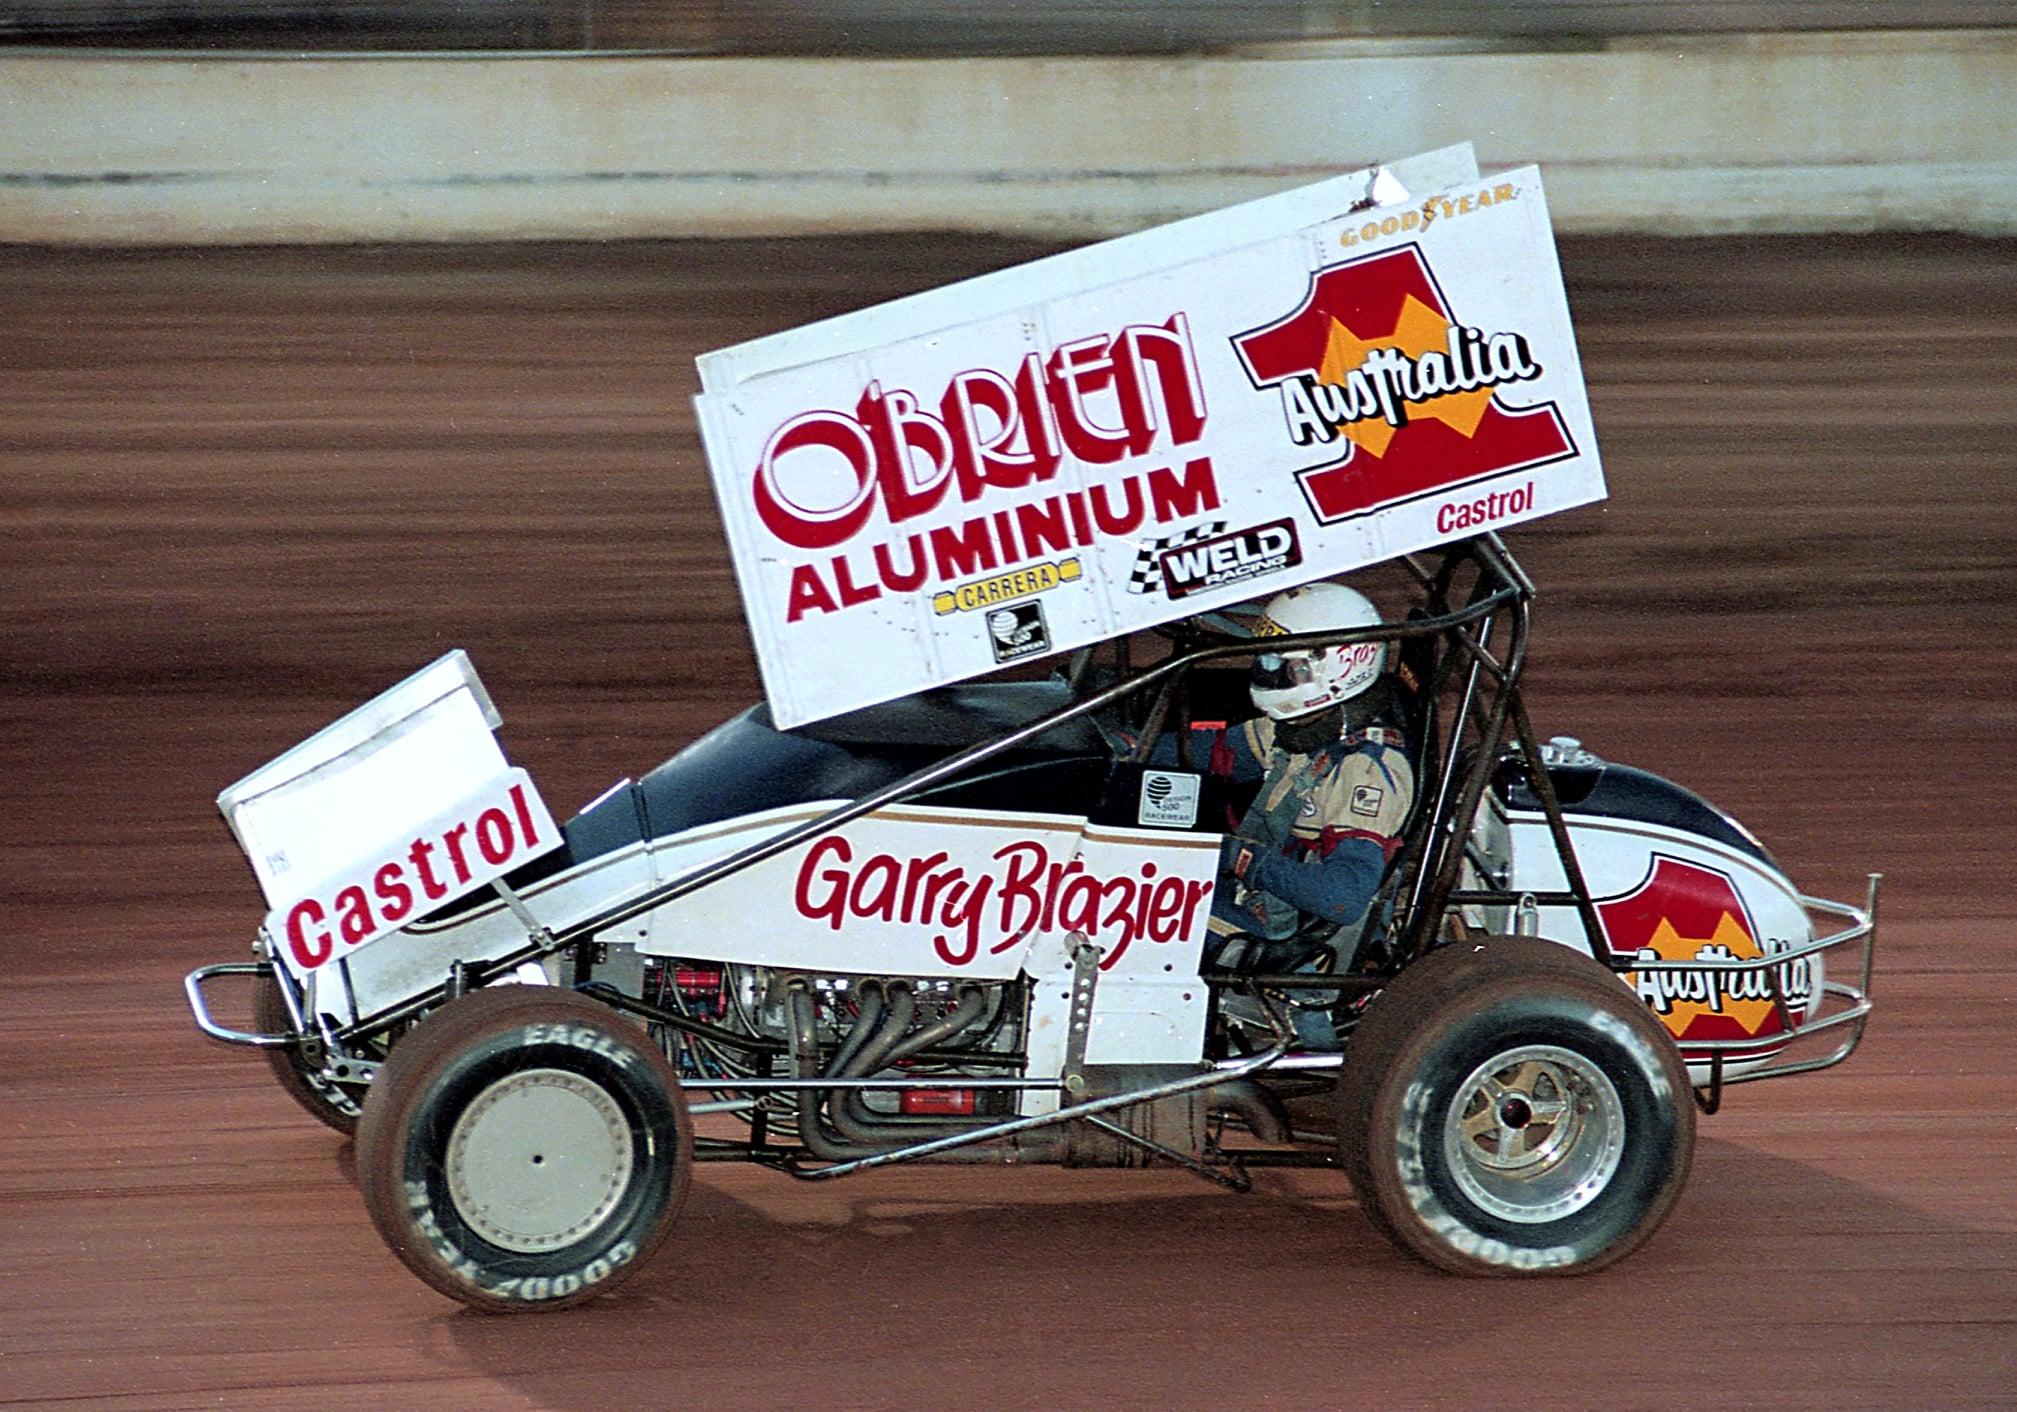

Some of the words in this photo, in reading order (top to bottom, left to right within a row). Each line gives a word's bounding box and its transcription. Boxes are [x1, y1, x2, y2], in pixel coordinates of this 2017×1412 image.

[1340, 183, 1513, 248] GOODYEAR
[1280, 323, 1543, 446] Australia
[787, 457, 1221, 622] ALUMINIUM
[1436, 483, 1535, 534] Castrol
[963, 567, 1053, 607] CARRERA
[1166, 526, 1293, 584] WELD
[1205, 555, 1288, 586] RACING
[286, 785, 541, 970] Castrol
[796, 836, 993, 966] Garry
[990, 841, 1213, 972] Brazier
